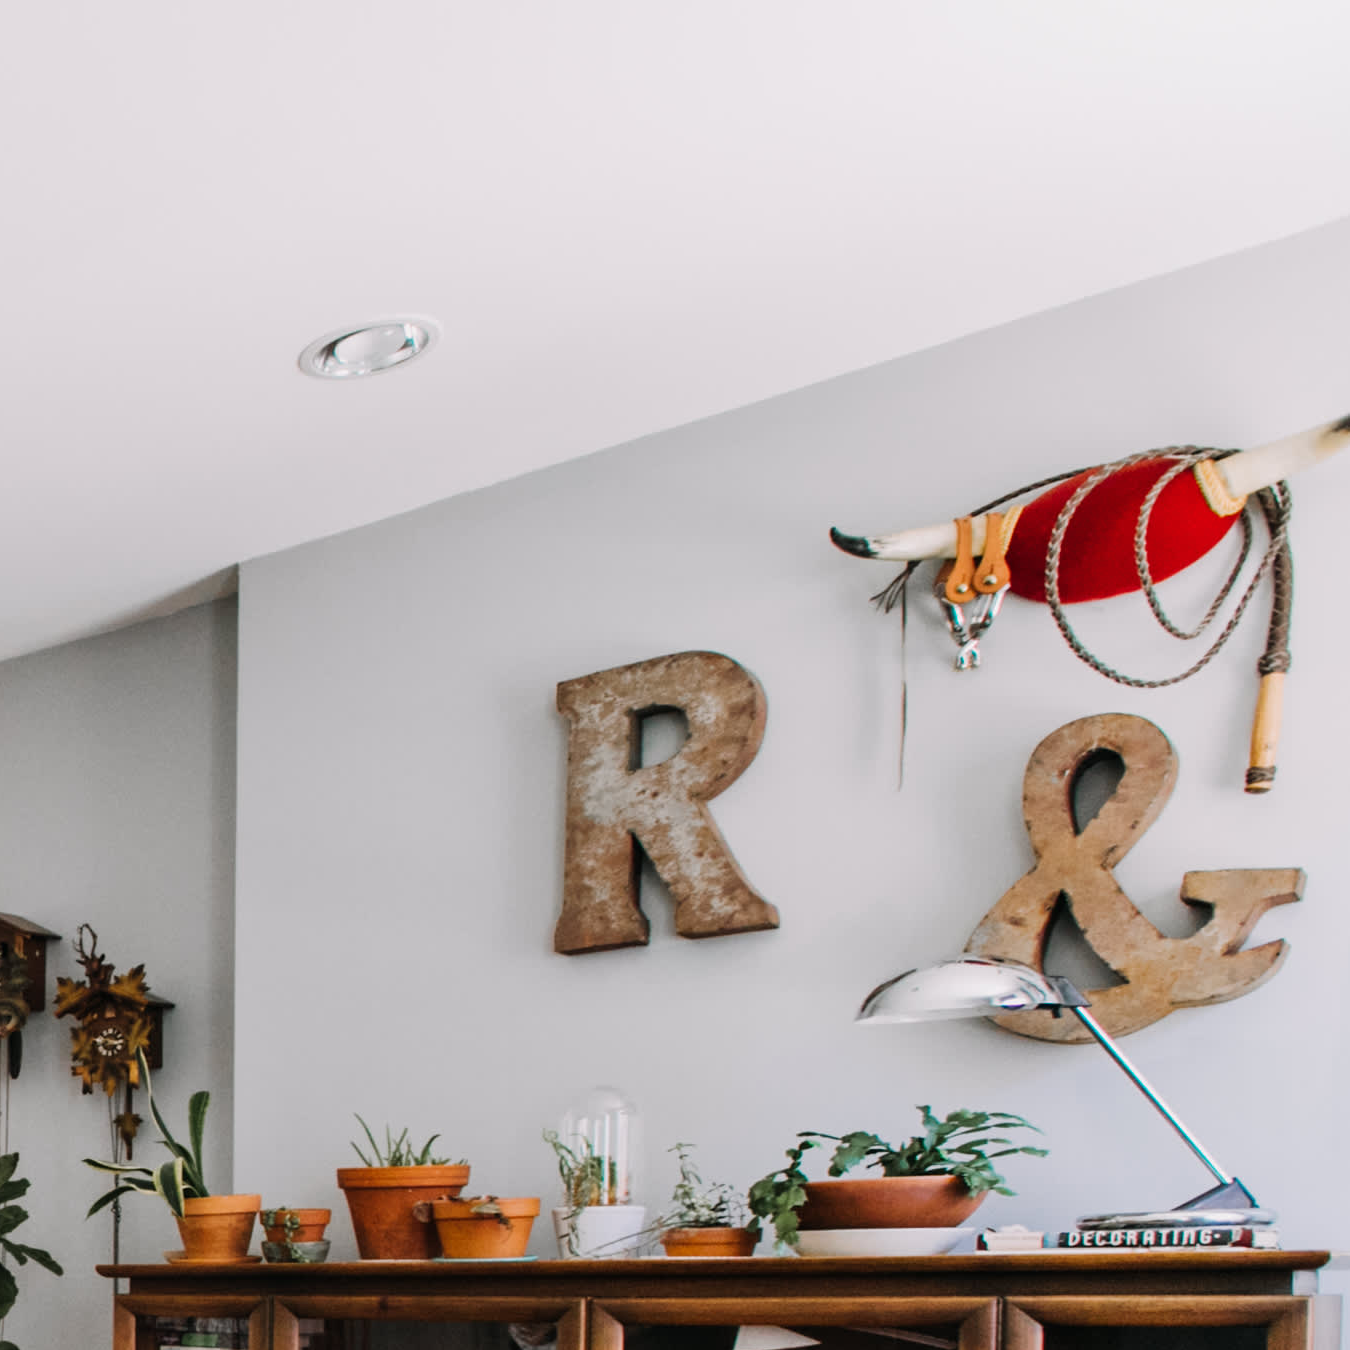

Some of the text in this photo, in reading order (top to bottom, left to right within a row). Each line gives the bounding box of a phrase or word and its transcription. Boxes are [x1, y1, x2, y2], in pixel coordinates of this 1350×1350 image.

[554, 650, 780, 955] R
[963, 712, 1307, 1044] &
[1068, 1229, 1213, 1247] DECORATING
